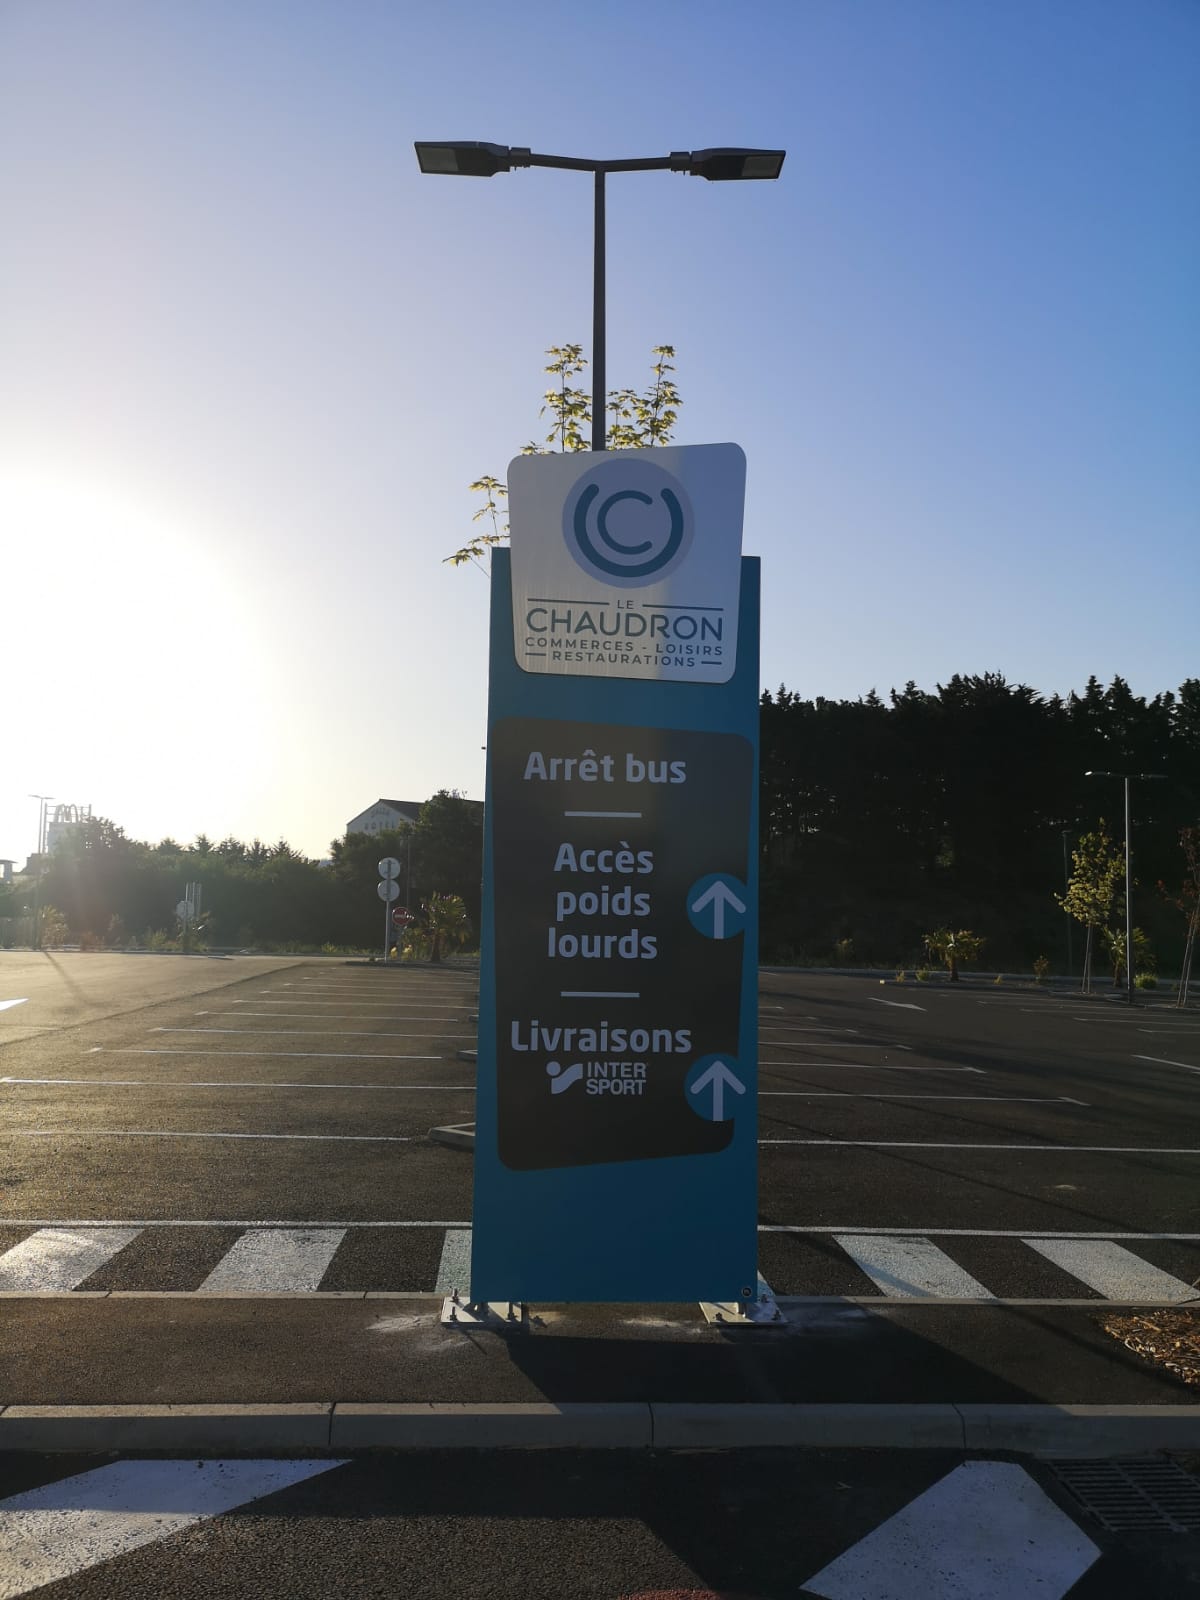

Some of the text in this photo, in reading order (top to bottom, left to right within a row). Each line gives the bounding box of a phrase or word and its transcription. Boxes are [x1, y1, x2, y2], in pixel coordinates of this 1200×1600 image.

[616, 599, 635, 610] LE
[526, 607, 724, 641] CHAUDRON
[525, 636, 635, 652] COMMERCES
[655, 643, 723, 656] LOISIRS
[552, 650, 696, 667] RESTAURATIONS
[523, 749, 687, 784] Arrêt bus
[553, 841, 654, 873] Accès
[556, 885, 651, 922] poids
[547, 927, 658, 960] lourds
[511, 1020, 692, 1053] Livraisons
[587, 1061, 647, 1077] INTER
[586, 1078, 647, 1095] SPORT
